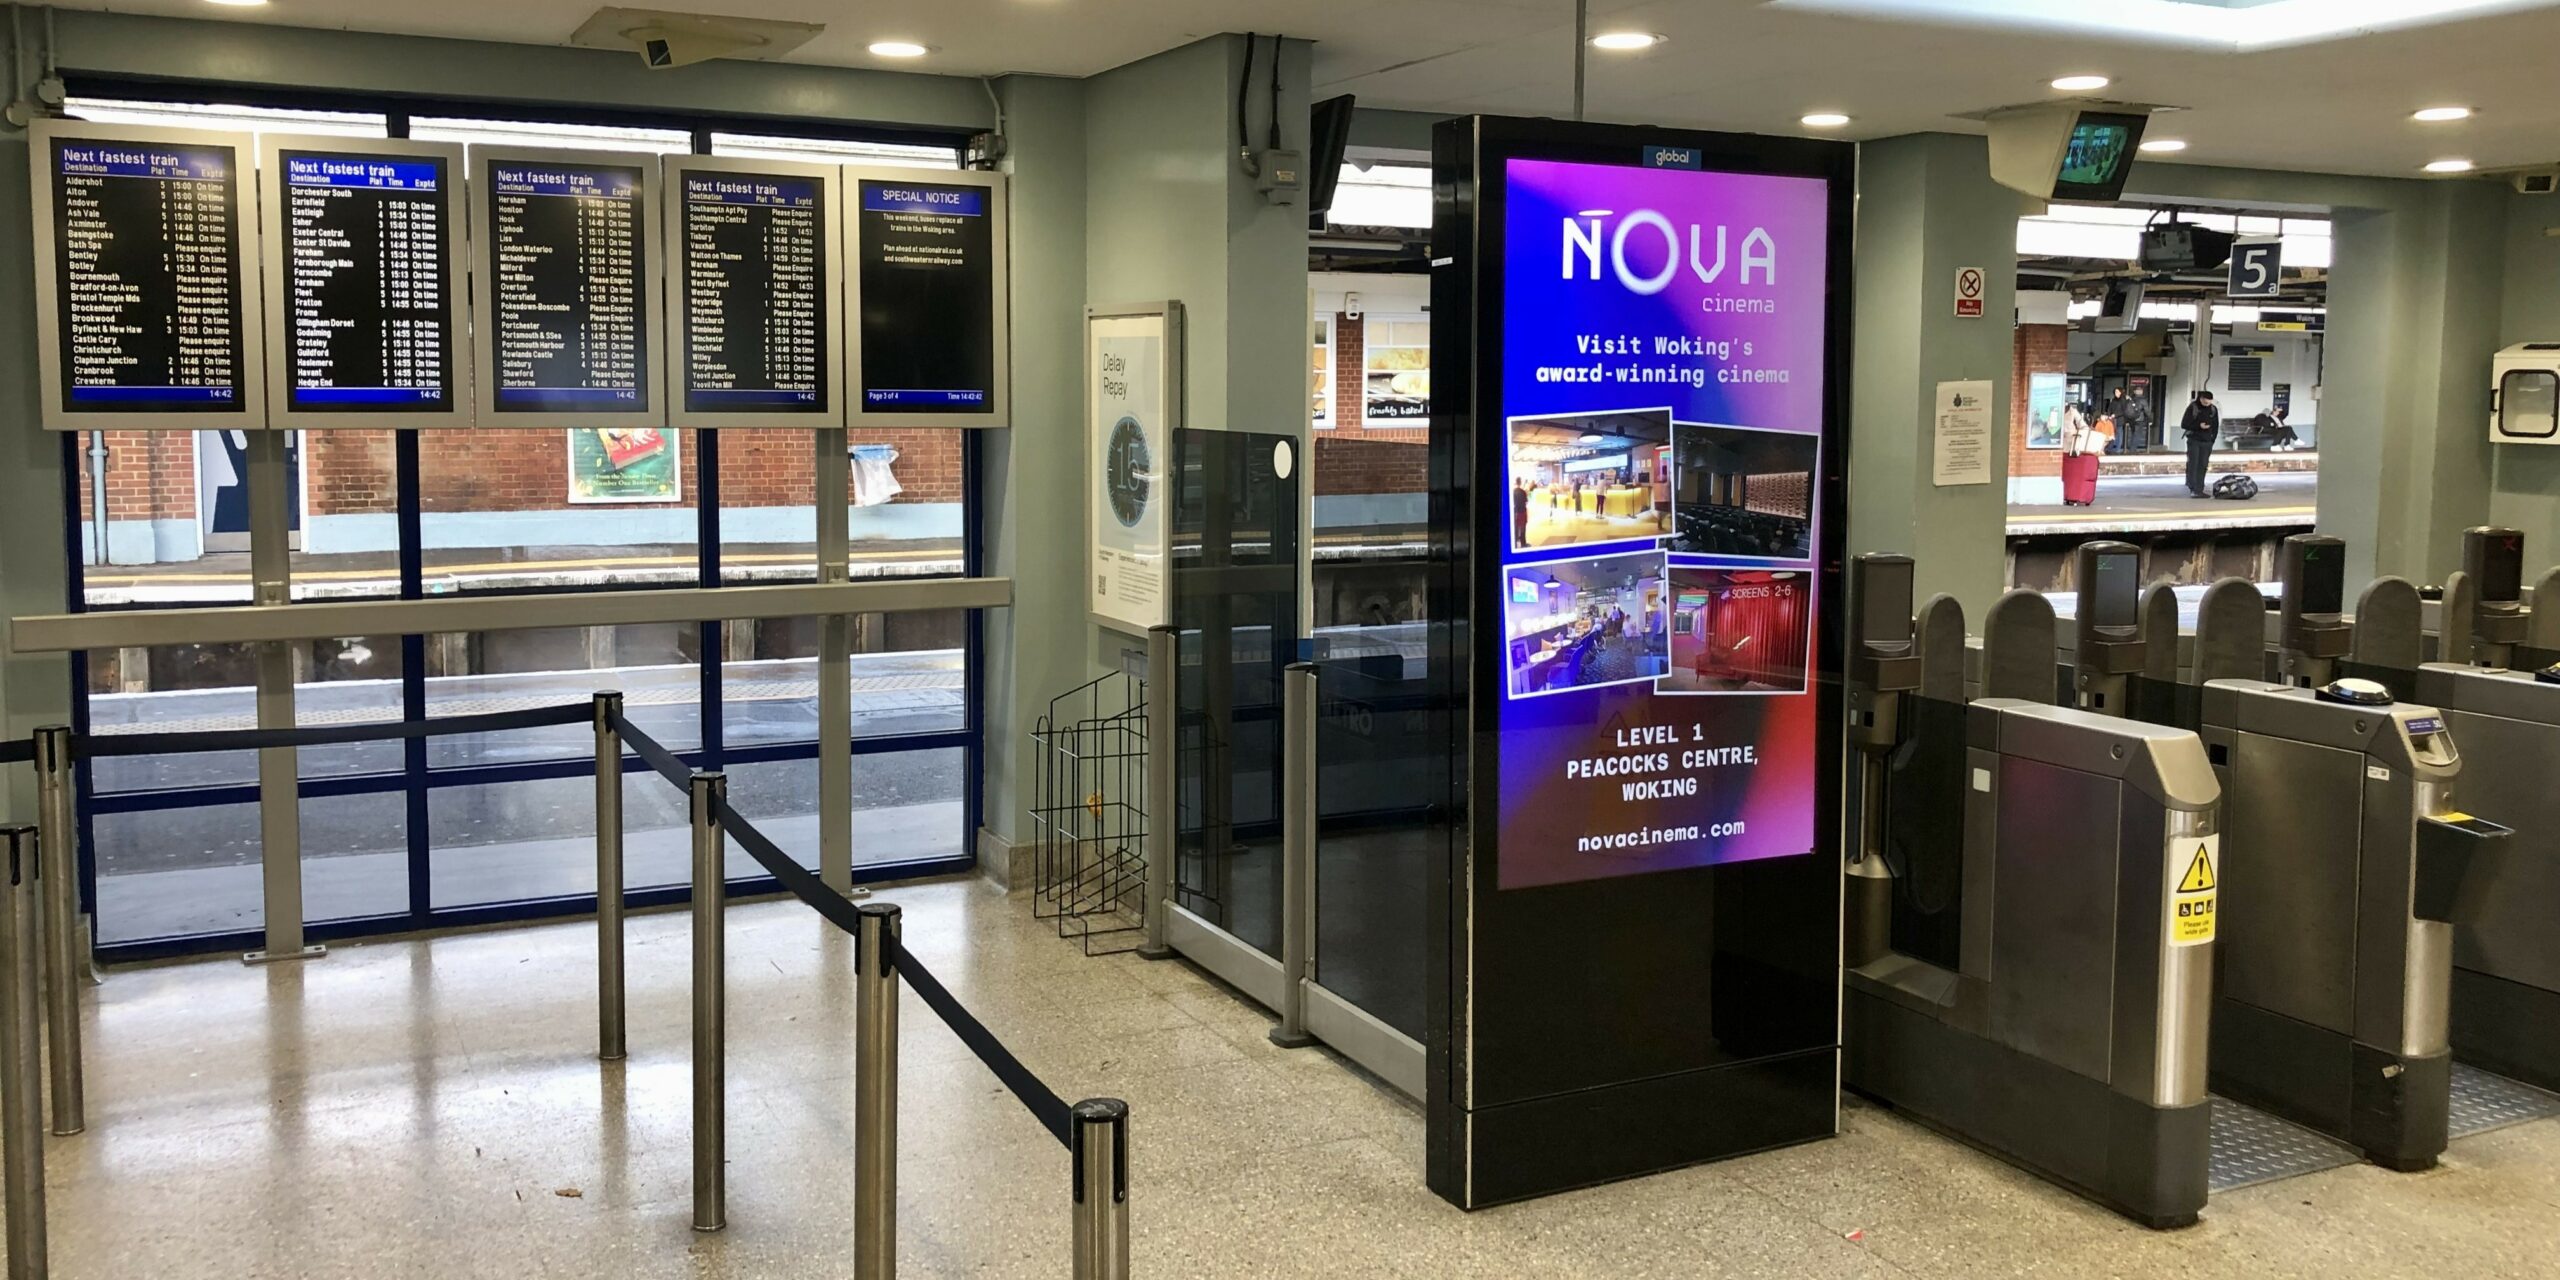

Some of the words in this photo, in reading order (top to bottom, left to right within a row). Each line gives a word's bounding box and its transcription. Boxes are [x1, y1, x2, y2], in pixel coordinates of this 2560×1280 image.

[64, 150, 94, 162] Next
[100, 151, 145, 165] fastest
[151, 154, 178, 166] train
[1656, 150, 1689, 166] global
[65, 163, 107, 172] Destination
[171, 168, 188, 176] Time
[290, 161, 318, 173] Next
[323, 162, 365, 176] fastest
[369, 165, 395, 176] train
[291, 175, 331, 183] Destination
[389, 178, 403, 186] Time
[498, 171, 523, 182] Next
[528, 172, 565, 184] fastest
[570, 175, 593, 185] train
[65, 177, 102, 186] Aldershot
[161, 181, 165, 189] 5
[197, 183, 207, 191] On
[208, 183, 224, 192] time
[499, 183, 534, 191] Destination
[588, 187, 601, 195] Time
[689, 181, 712, 191] Next
[716, 182, 752, 194] fastest
[756, 185, 777, 195] train
[66, 187, 87, 196] Alton
[291, 187, 331, 196] Dorchester
[331, 188, 352, 197] South
[689, 192, 722, 200] Destination
[883, 190, 922, 202] SPECIAL
[926, 192, 960, 204] NOTICE
[66, 198, 98, 206] Andover
[67, 208, 82, 216] Ash
[82, 209, 100, 217] Vale
[291, 207, 324, 218] Eastleigh
[292, 217, 312, 226] Esher
[67, 229, 114, 240] Basingstoke
[292, 227, 317, 236] Exeter
[317, 228, 344, 237] Central
[922, 226, 942, 234] Woking
[68, 250, 98, 261] Bentley
[293, 247, 324, 256] Fareham
[1562, 208, 1776, 295] NOVA
[69, 261, 94, 271] Botley
[69, 271, 120, 280] Bournemouth
[294, 278, 324, 286] Farnham
[424, 282, 438, 290] time
[294, 288, 313, 296] Fleet
[71, 303, 122, 312] Brockenhurst
[294, 298, 322, 306] Fratton
[1702, 293, 1775, 314] cinema
[71, 313, 115, 322] Brookwood
[295, 308, 318, 316] Frome
[296, 338, 327, 348] Grateley
[1577, 335, 1641, 355] Visit
[1655, 337, 1753, 360] Woking's
[73, 345, 122, 354] Christchurch
[296, 348, 329, 356] Guildford
[73, 355, 105, 365] Clapham
[106, 356, 138, 364] Junction
[1103, 353, 1126, 376] Delay
[297, 368, 322, 376] Havant
[1536, 363, 1704, 388] award-winning
[1718, 367, 1790, 384] cinema
[74, 376, 116, 384] Crewkerne
[297, 378, 319, 387] Hedge
[319, 378, 333, 386] End
[1103, 376, 1128, 400] Repay
[210, 390, 232, 398] 14:42
[869, 392, 882, 401] Page
[1117, 442, 1140, 490] 15
[1732, 587, 1770, 599] SCREENS
[1775, 585, 1792, 597] 2-6
[1617, 726, 1679, 747] LEVEL
[1693, 724, 1703, 741] 1
[1567, 752, 1669, 779] PEACOCKS
[1682, 746, 1759, 768] CENTRE,
[1623, 778, 1697, 802] WOKING
[1578, 820, 1745, 852] novacinema.com
